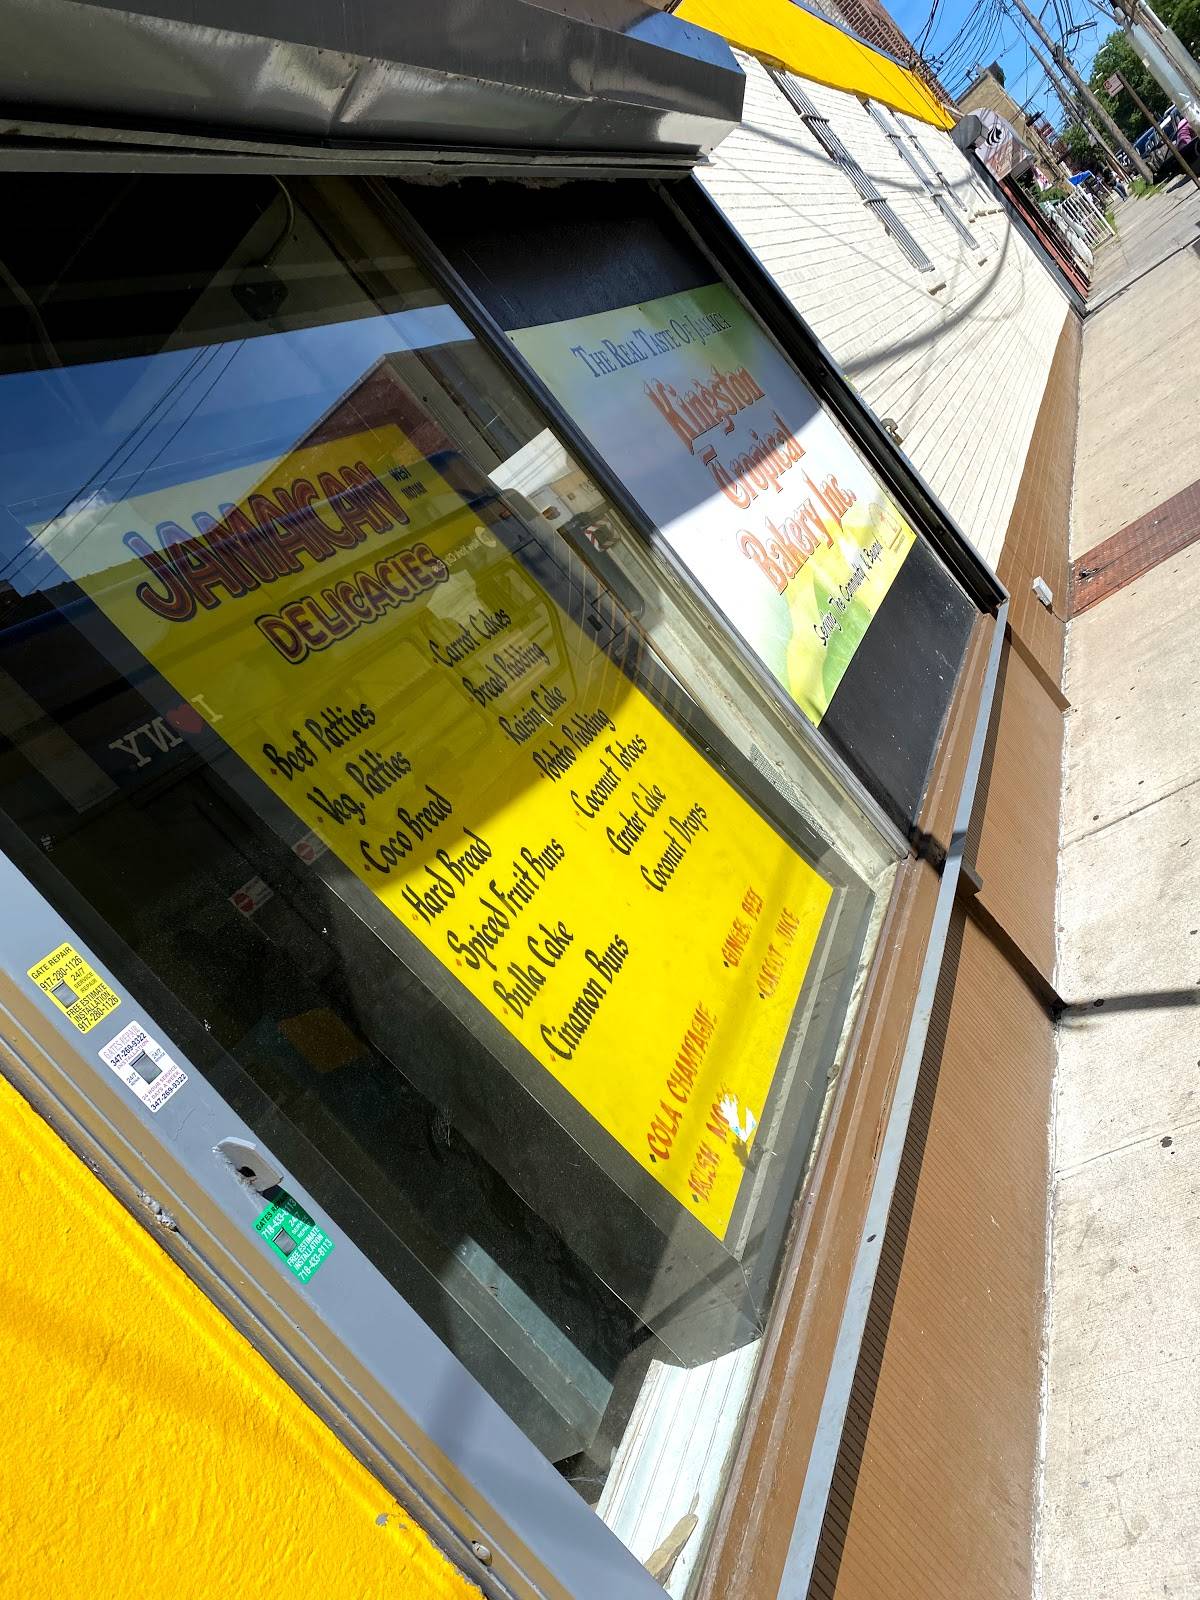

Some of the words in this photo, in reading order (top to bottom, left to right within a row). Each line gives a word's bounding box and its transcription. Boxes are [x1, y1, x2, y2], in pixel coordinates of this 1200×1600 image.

[643, 365, 766, 455] Kingston
[700, 408, 807, 510] Tropical
[122, 460, 410, 622] JAMAICAN
[735, 496, 836, 596] Bakery
[255, 542, 449, 664] DELICACIES
[428, 625, 480, 668] Carrot
[477, 608, 511, 640] Cakes
[462, 664, 508, 708] Bread
[493, 642, 550, 683] Pudding
[262, 729, 320, 782] Beef
[304, 701, 376, 753] Patties
[498, 706, 546, 746] Raisin
[531, 683, 567, 716] Cake
[533, 740, 577, 783] Potato
[561, 706, 616, 754] Pudding
[306, 786, 366, 826] Veg.
[345, 748, 412, 800] Patties
[570, 758, 621, 819] Coconut
[604, 734, 648, 772] Totoes
[359, 826, 412, 875] Coco
[397, 784, 453, 843] Bread
[606, 811, 647, 856] Grater
[631, 782, 667, 818] Cake
[640, 832, 687, 893] Coconut
[668, 802, 708, 848] Drops
[401, 864, 456, 926] Hard
[436, 826, 493, 887] Bread
[446, 895, 511, 972] Spiced
[487, 860, 540, 920] Fruit
[520, 837, 566, 881] Buns
[31, 962, 50, 980] GATE
[47, 946, 72, 967] REPAIR
[39, 955, 83, 991] 917-280-1126
[70, 967, 86, 982] 24/7
[493, 960, 547, 1020] Bulla
[527, 918, 574, 968] Cake
[584, 933, 631, 984] Buns
[66, 1000, 83, 1018] FREE
[80, 983, 107, 1006] ESTIMATE
[74, 991, 111, 1022] INSTALLATION
[77, 995, 119, 1032] 917-280-1126
[110, 1032, 147, 1067] 347-269-9322
[150, 1073, 187, 1111] 347-269-9322
[647, 1099, 683, 1161] COLA
[255, 1212, 272, 1230] GATES
[287, 1249, 300, 1266] FREE
